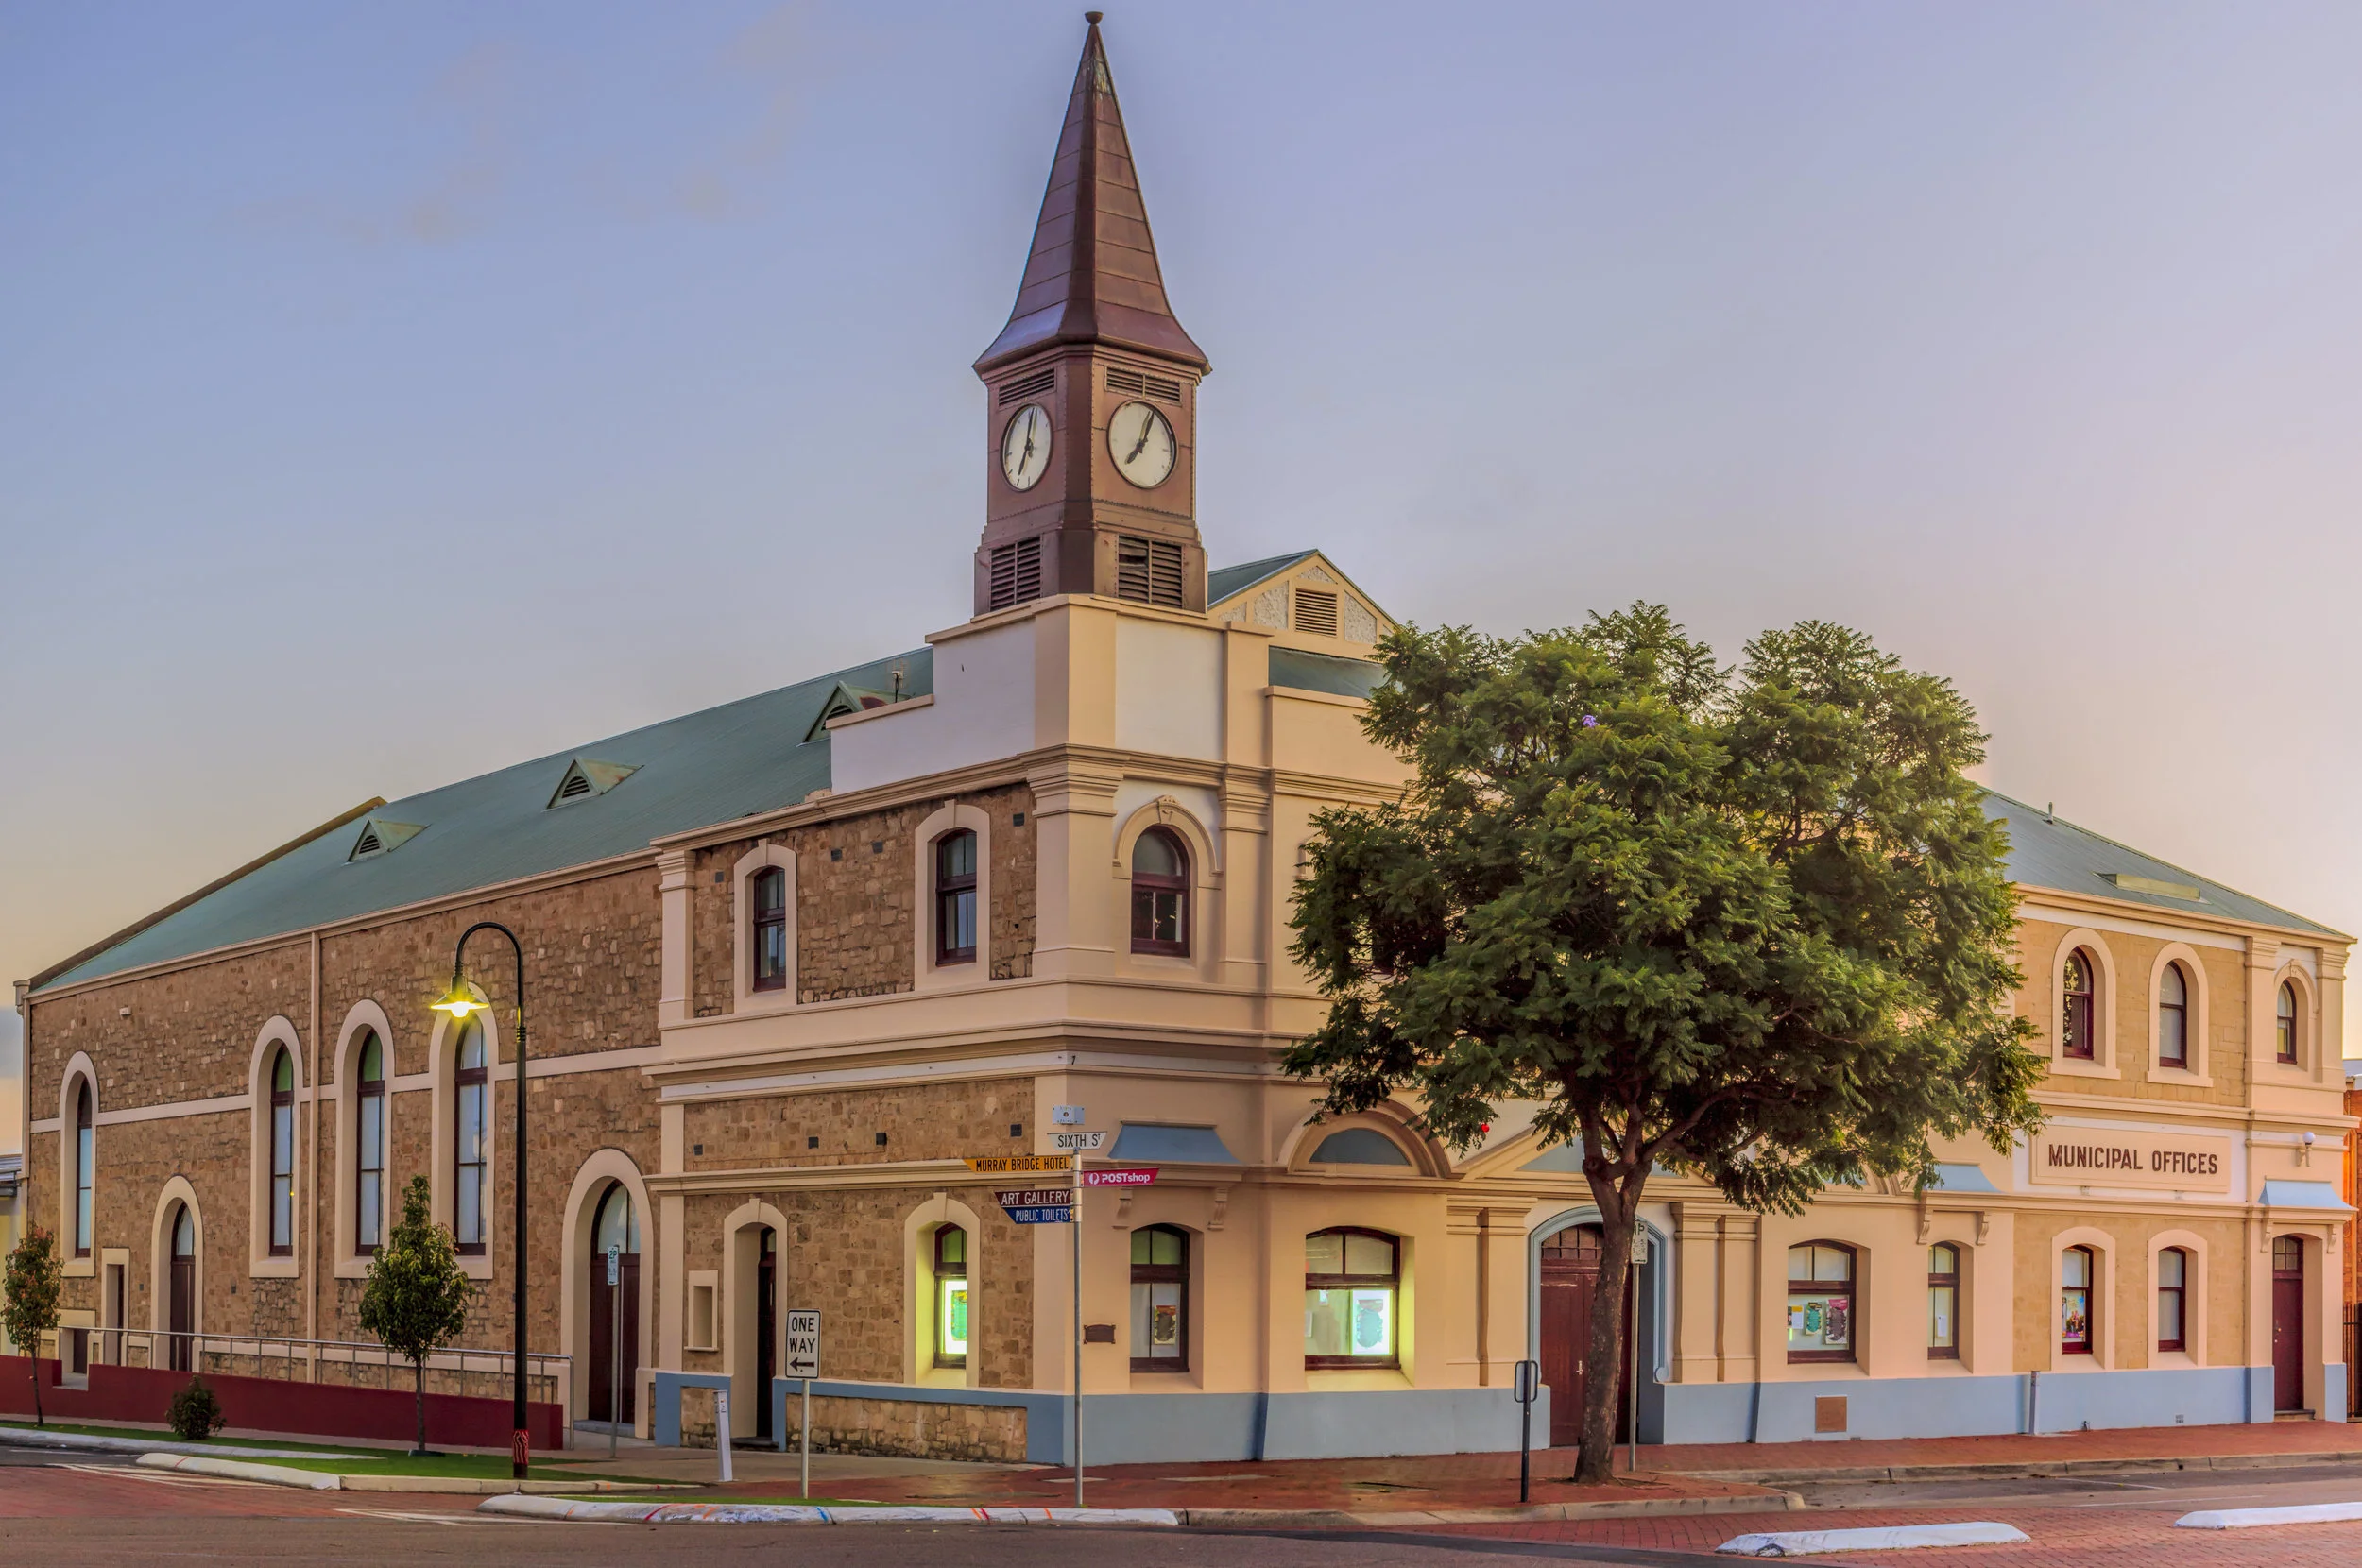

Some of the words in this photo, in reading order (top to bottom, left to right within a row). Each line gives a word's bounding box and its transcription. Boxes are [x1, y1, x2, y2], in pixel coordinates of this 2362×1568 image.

[1057, 1133, 1087, 1148] SIXTH
[976, 1159, 1008, 1172] MURRAY
[1011, 1158, 1040, 1171] BRIDGE
[1043, 1157, 1069, 1170] HOTEL
[2048, 1144, 2144, 1170] MUNICIPAL
[2151, 1150, 2218, 1175] OFFICES
[1101, 1172, 1151, 1184] POSTshop
[1001, 1192, 1020, 1205] ART
[1024, 1190, 1069, 1204] GALLERY
[1016, 1209, 1039, 1221] PUBLIC
[1042, 1208, 1068, 1221] TOILETS
[608, 1250, 618, 1260] 2P
[792, 1317, 814, 1332] ONE
[789, 1338, 816, 1354] WAY
